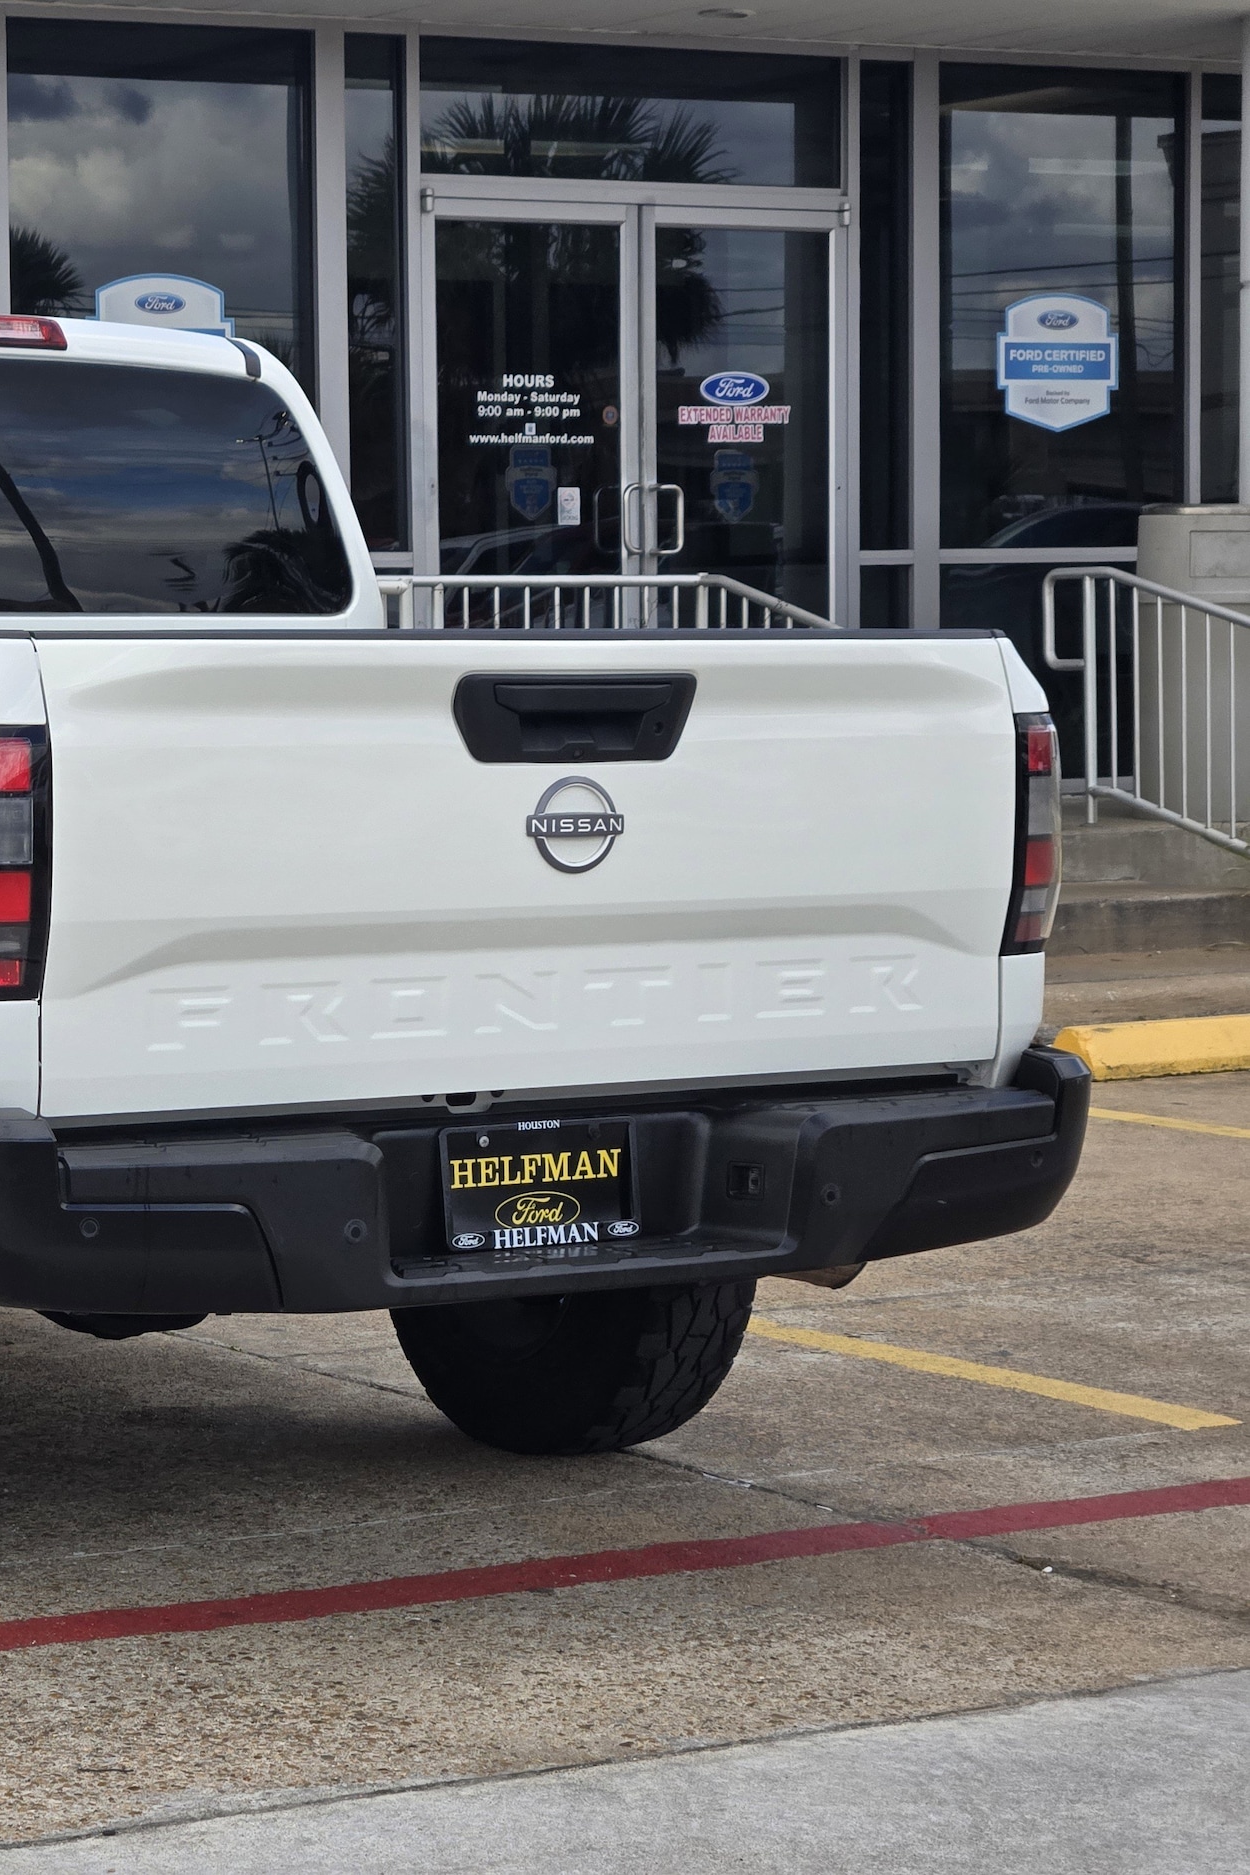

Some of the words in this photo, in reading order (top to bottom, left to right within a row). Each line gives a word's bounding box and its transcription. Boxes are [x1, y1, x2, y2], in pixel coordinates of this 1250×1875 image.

[1010, 349, 1042, 361] FORD
[1045, 350, 1105, 361] CERTIFIED
[1032, 365, 1084, 373] PRE-OWNED
[502, 374, 554, 388] HOURS
[477, 391, 520, 404] Monday
[530, 392, 580, 405] Saturday
[477, 405, 502, 417] 9:00
[506, 408, 524, 417] am
[534, 406, 559, 418] 9:00
[562, 408, 581, 419] pm
[678, 406, 732, 424] EXTENDED
[734, 406, 790, 424] WARRANTY
[469, 433, 594, 445] www.helfmanford.com
[708, 425, 764, 442] AVAILABLE
[532, 818, 622, 832] NISSAN
[144, 954, 925, 1051] FRONTIER
[517, 1120, 561, 1131] HOUSTON
[450, 1148, 622, 1189] HELFMAN
[512, 1196, 564, 1225] Ford
[493, 1222, 599, 1249] HELFMAN
